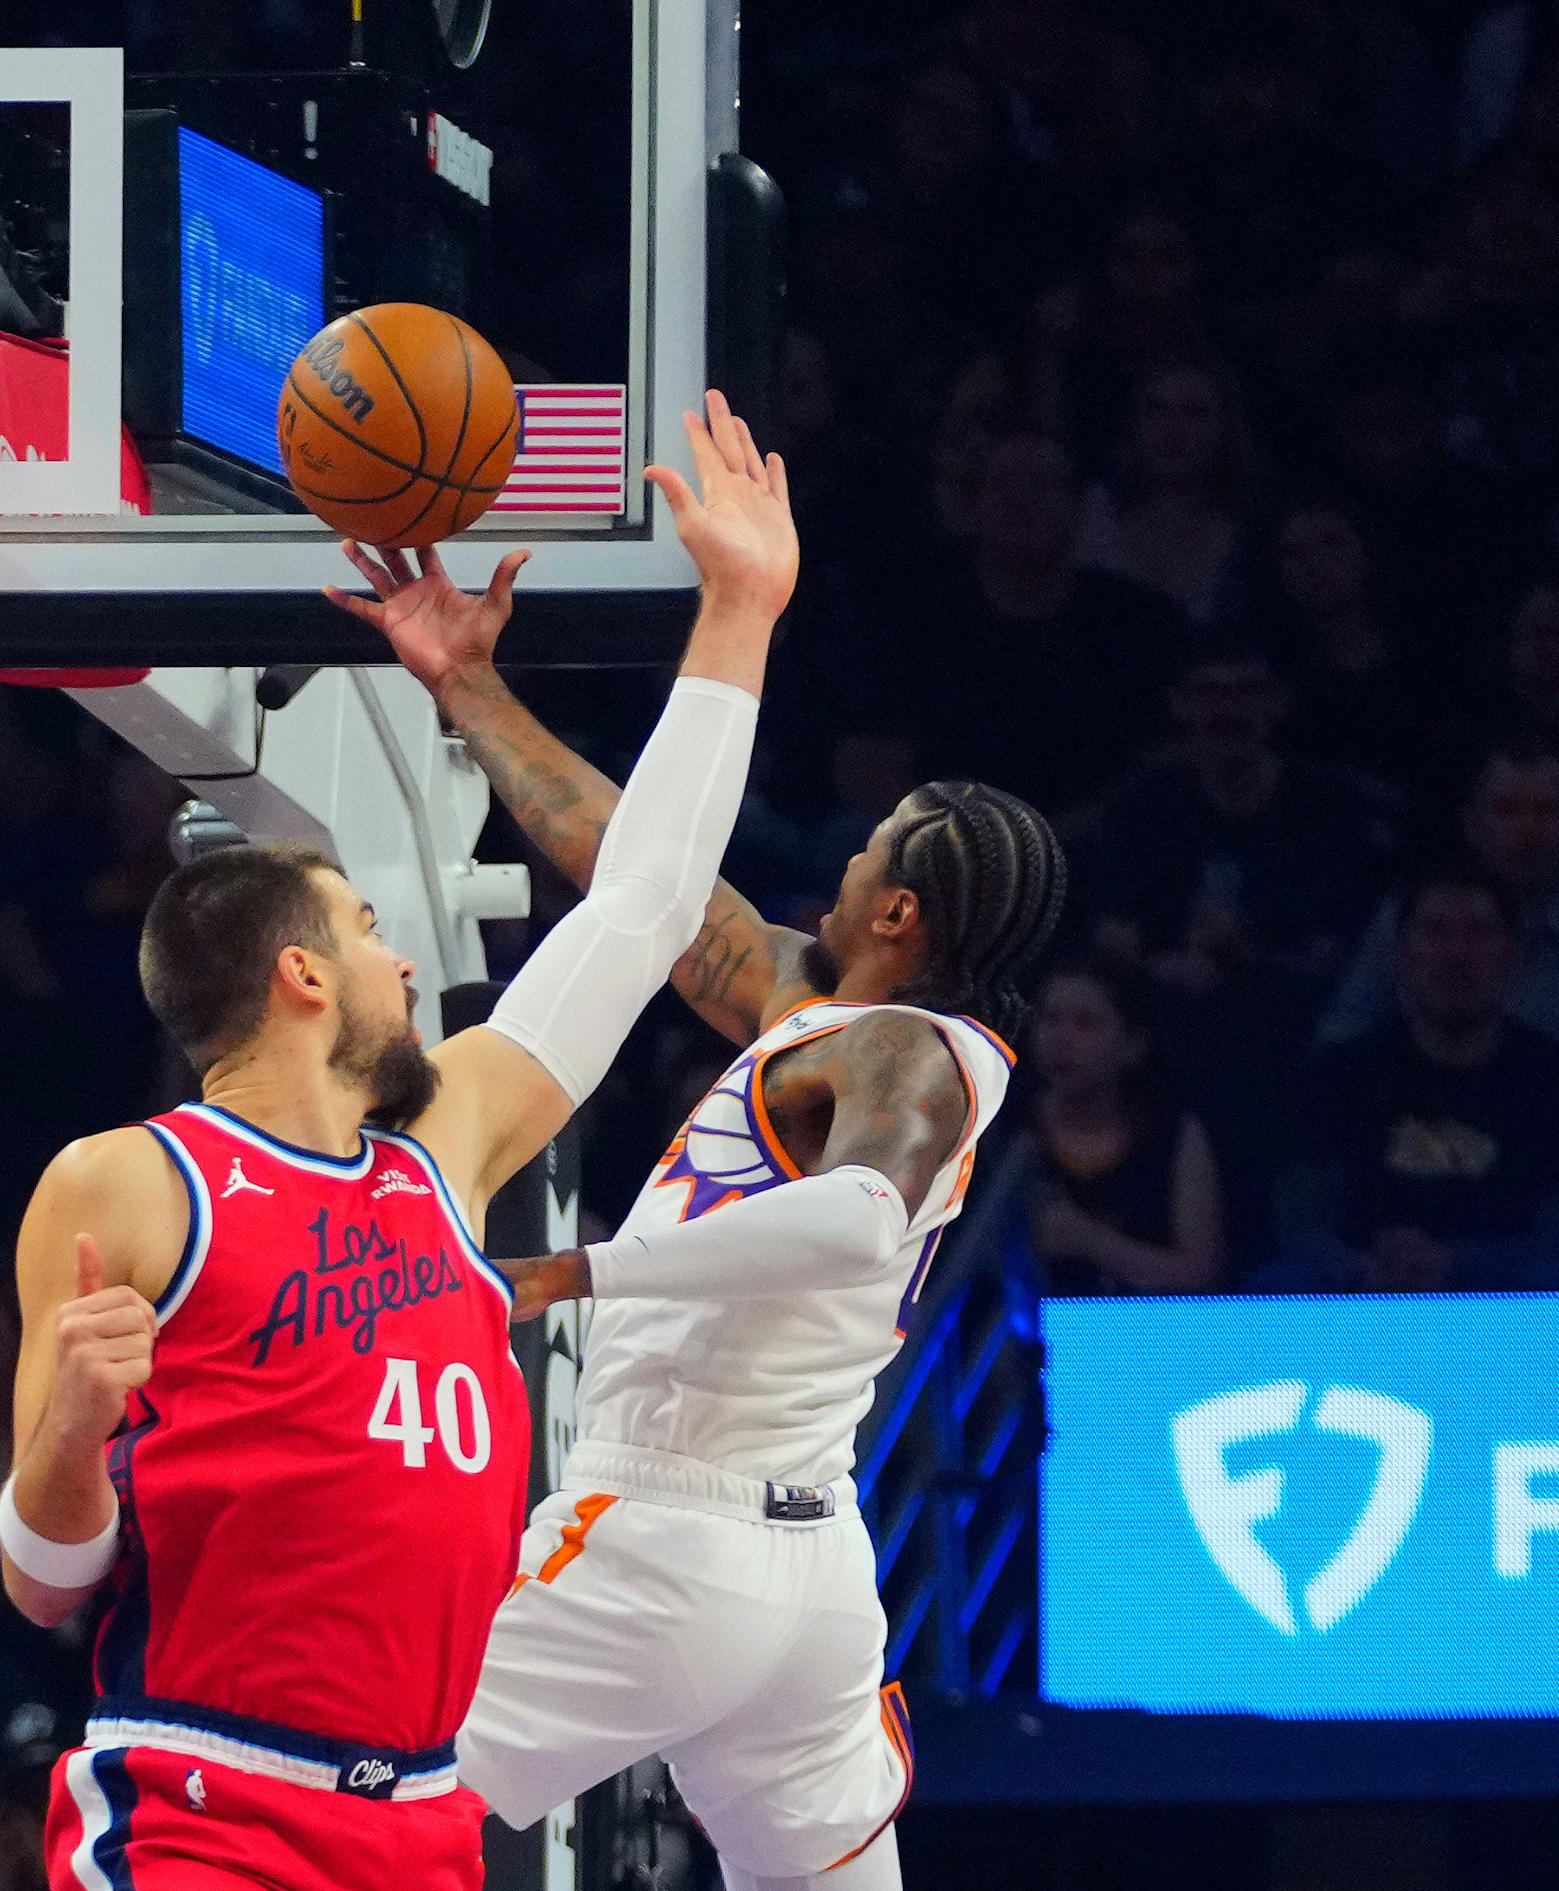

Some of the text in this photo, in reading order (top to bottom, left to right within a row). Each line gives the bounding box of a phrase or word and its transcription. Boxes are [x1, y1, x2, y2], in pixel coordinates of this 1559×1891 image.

[307, 1206, 397, 1276] Los
[247, 1238, 463, 1369] Angeles
[367, 1356, 491, 1475] 40
[348, 1759, 396, 1791] Clips
